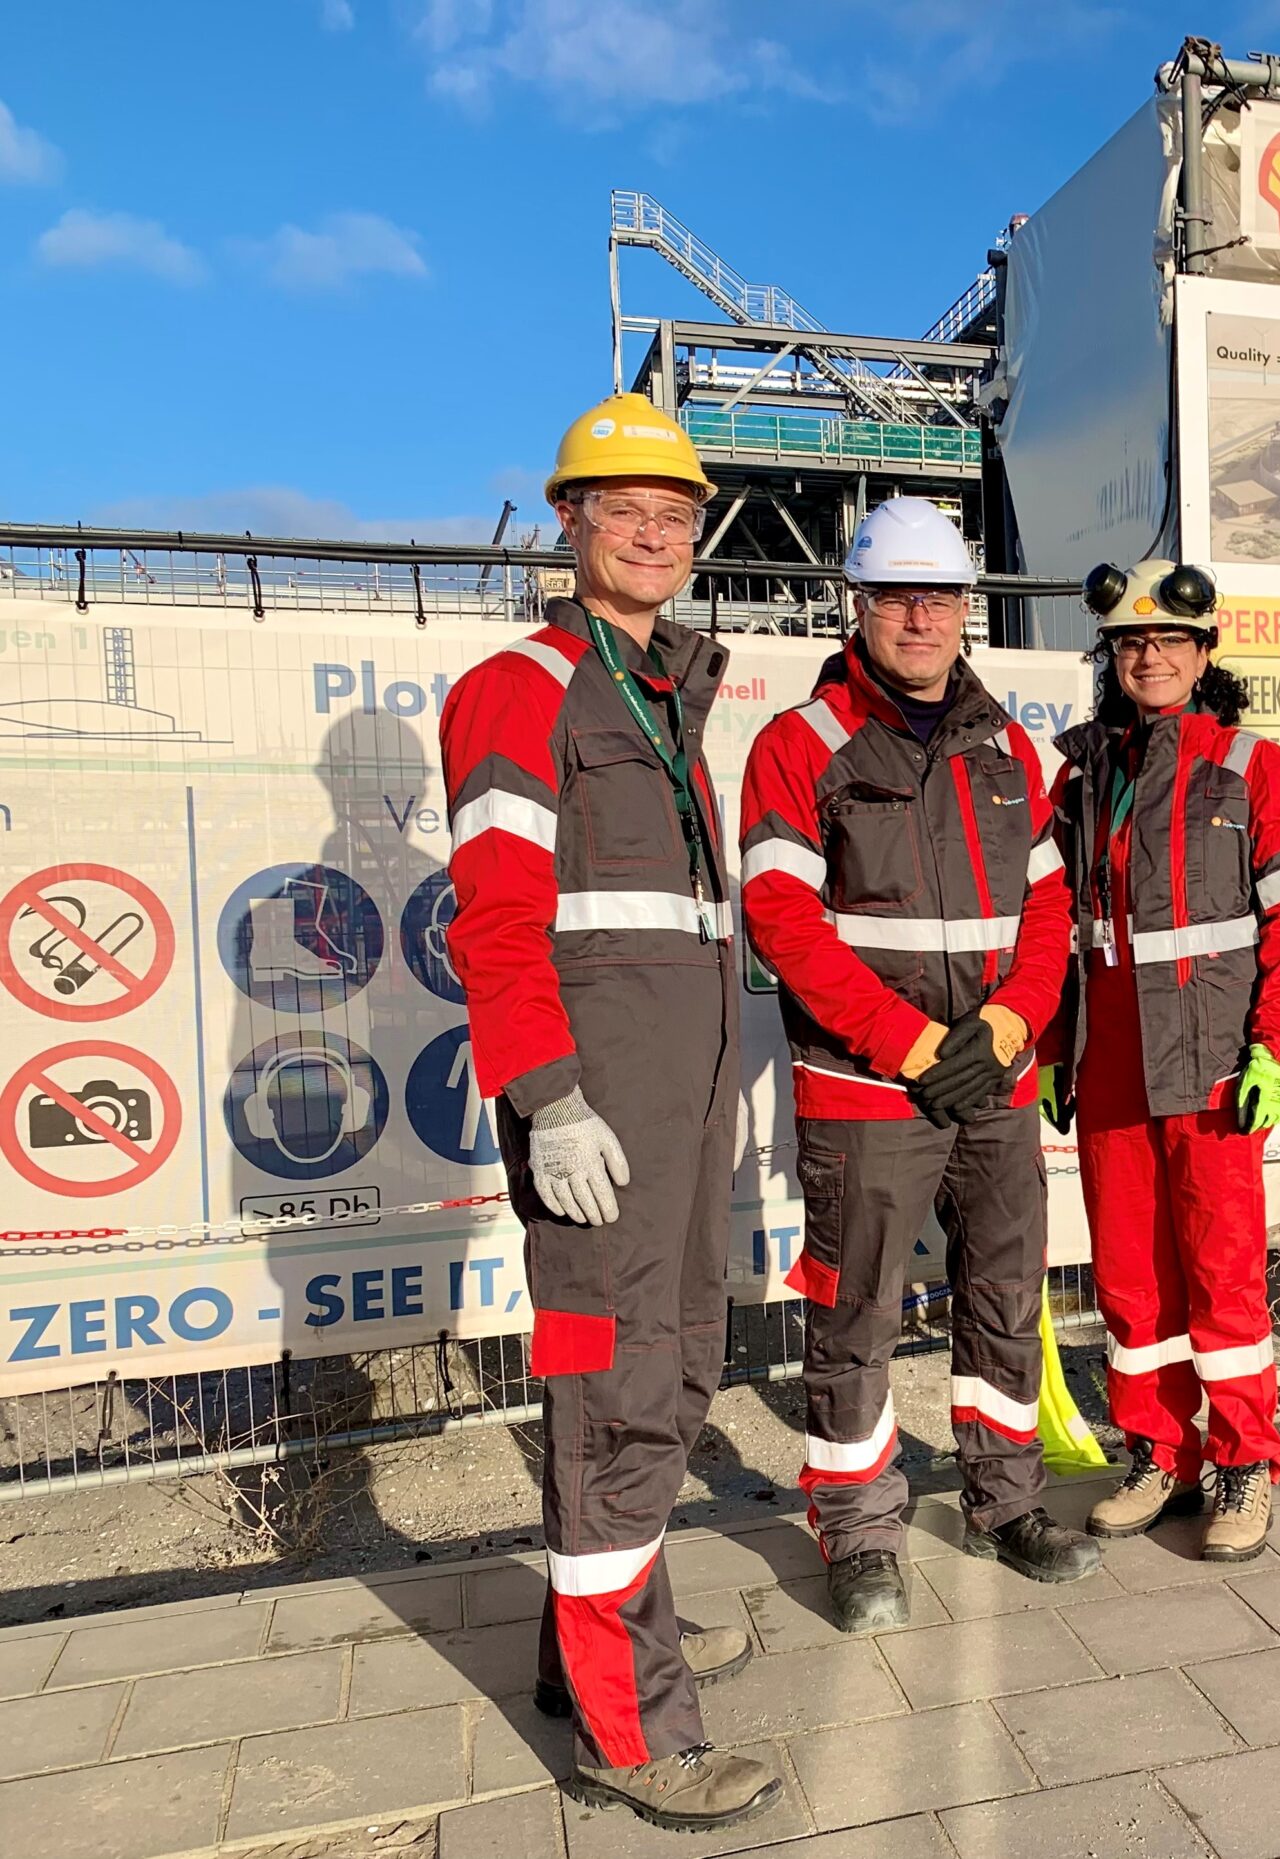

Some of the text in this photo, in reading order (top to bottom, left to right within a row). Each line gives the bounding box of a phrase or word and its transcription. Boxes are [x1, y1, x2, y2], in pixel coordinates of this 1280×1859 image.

[1216, 345, 1271, 366] Quality
[74, 627, 87, 650] 1
[313, 660, 452, 717] Plot
[1000, 691, 1073, 736] ley
[8, 1287, 233, 1363] ZERO
[305, 1265, 424, 1327] SEE
[449, 1257, 523, 1314] IT,
